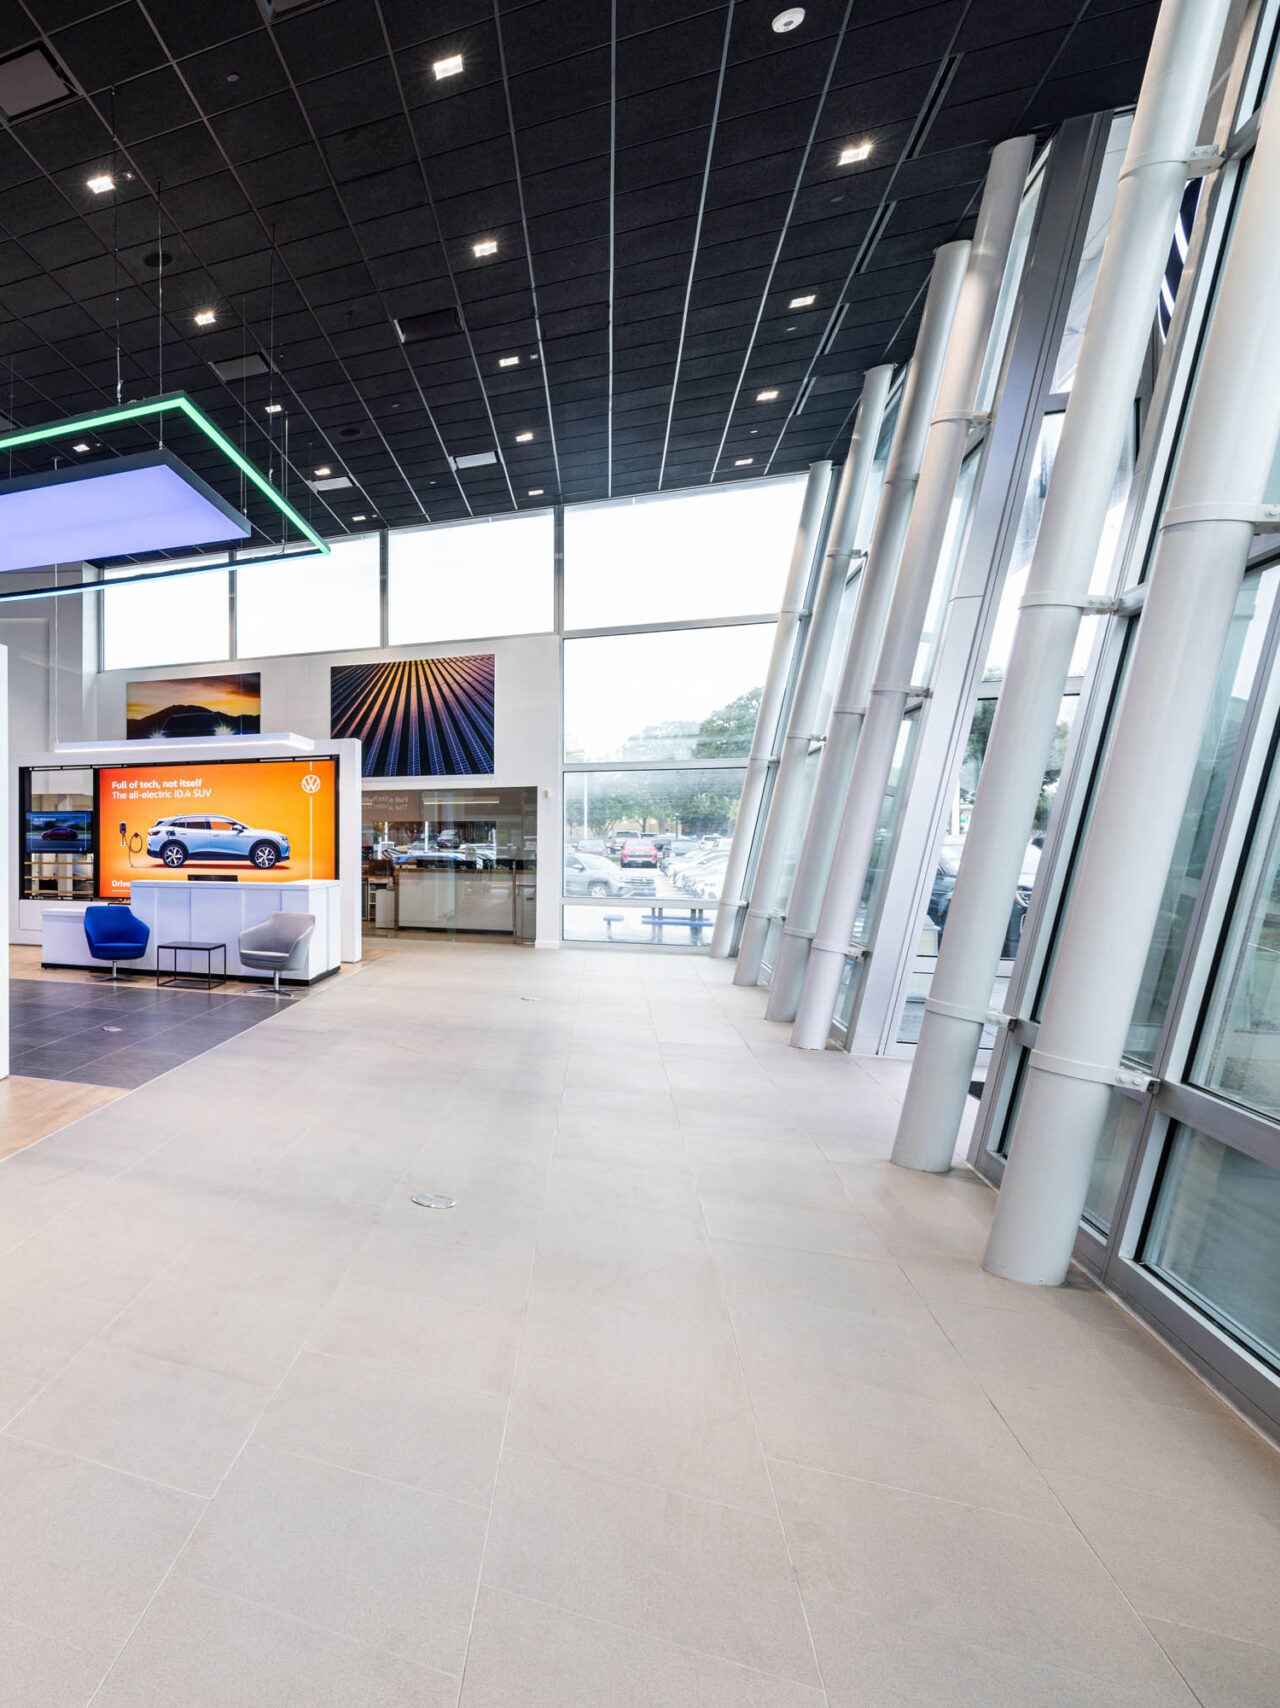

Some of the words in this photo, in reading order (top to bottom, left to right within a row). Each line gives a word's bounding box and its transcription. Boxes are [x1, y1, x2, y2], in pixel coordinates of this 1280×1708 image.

[112, 781, 127, 789] Full
[128, 780, 138, 788] of
[140, 779, 160, 789] tech,
[162, 780, 178, 788] not
[179, 778, 202, 787] itself
[112, 791, 127, 799] The
[128, 789, 172, 799] all-electric
[174, 789, 191, 798] ID.4
[193, 788, 212, 798] SUV
